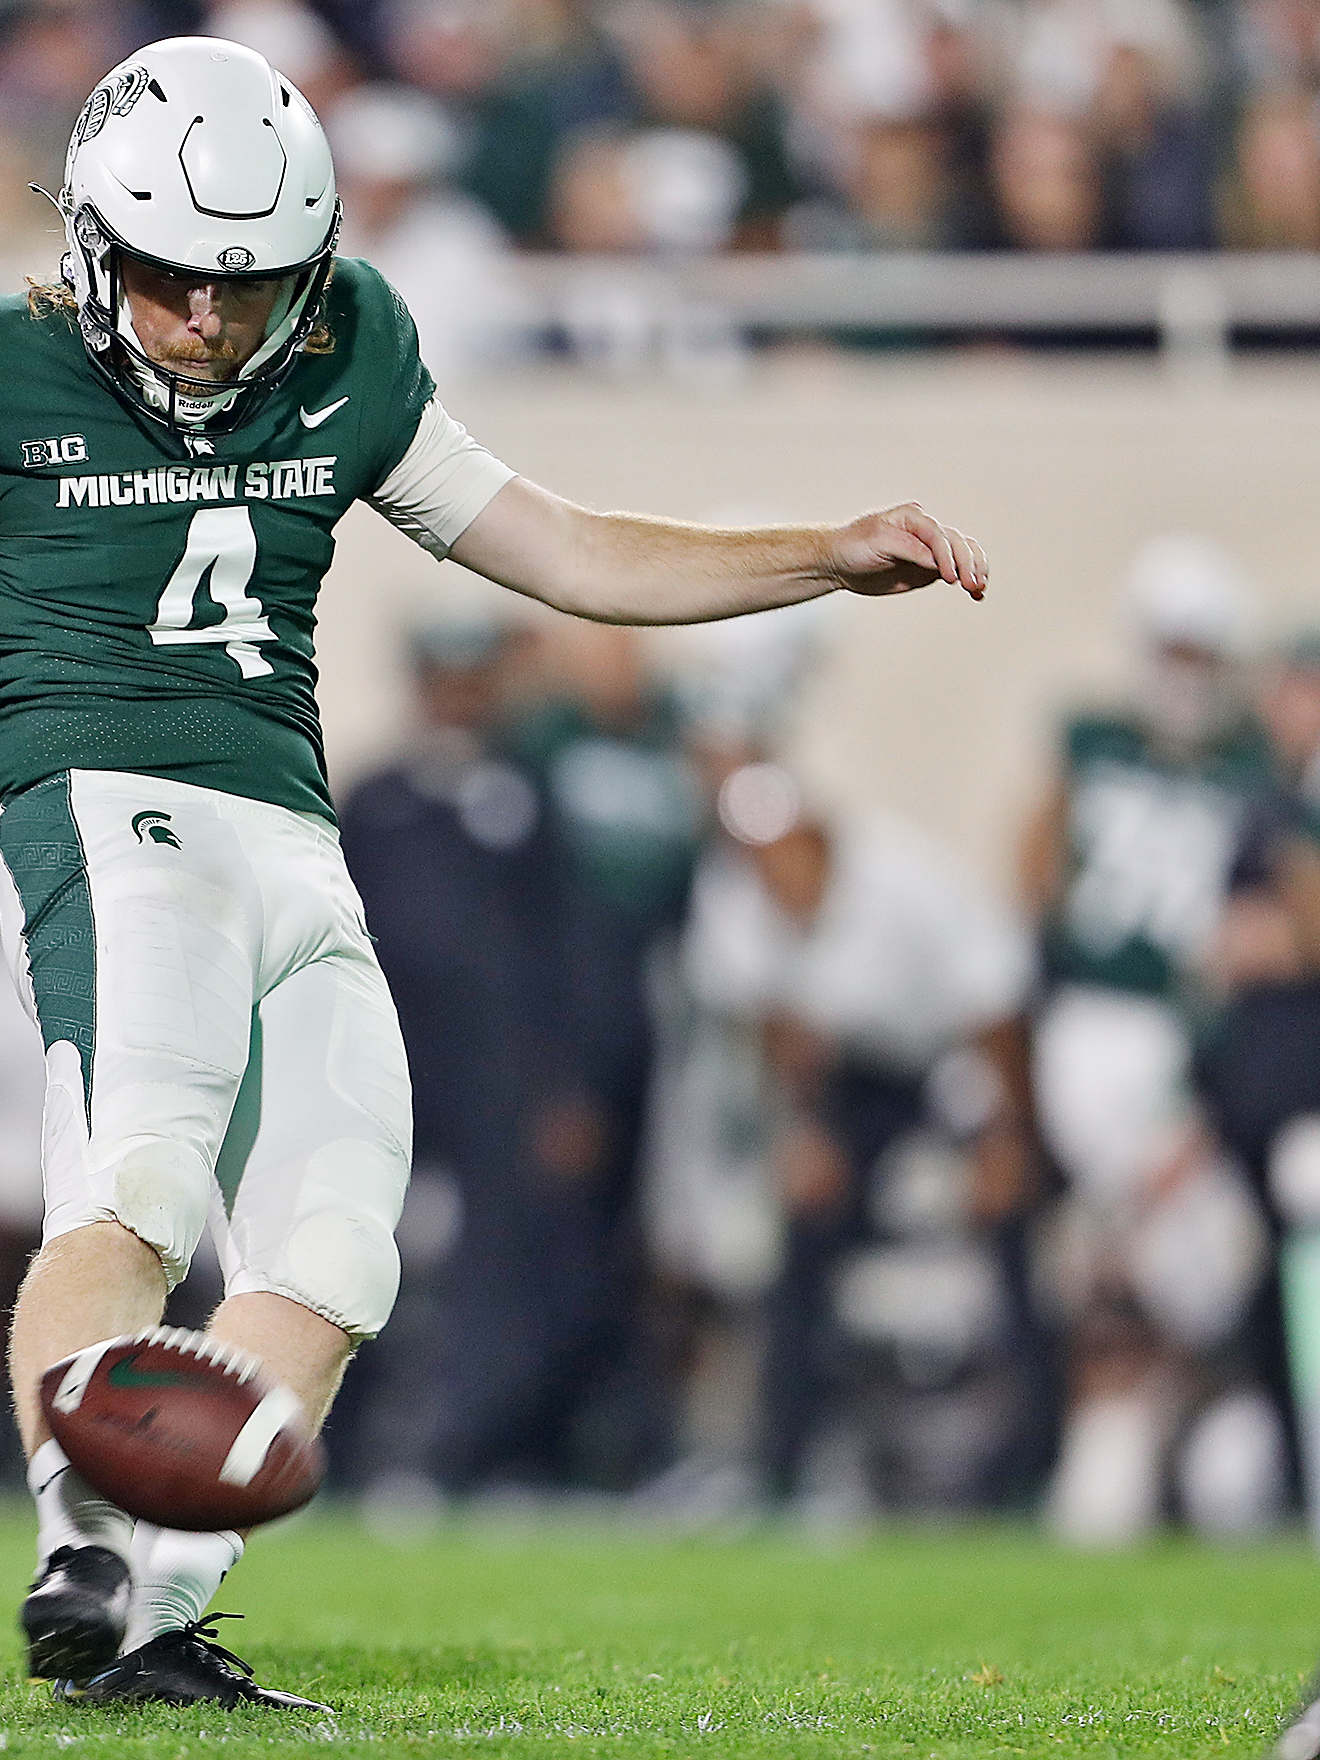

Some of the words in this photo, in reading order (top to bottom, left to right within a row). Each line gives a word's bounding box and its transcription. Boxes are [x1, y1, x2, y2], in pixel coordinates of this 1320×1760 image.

[225, 252, 248, 264] 125
[178, 400, 214, 409] Riddell
[56, 465, 238, 508] MICHIGAN
[244, 456, 338, 500] STATE
[145, 505, 280, 680] 4
